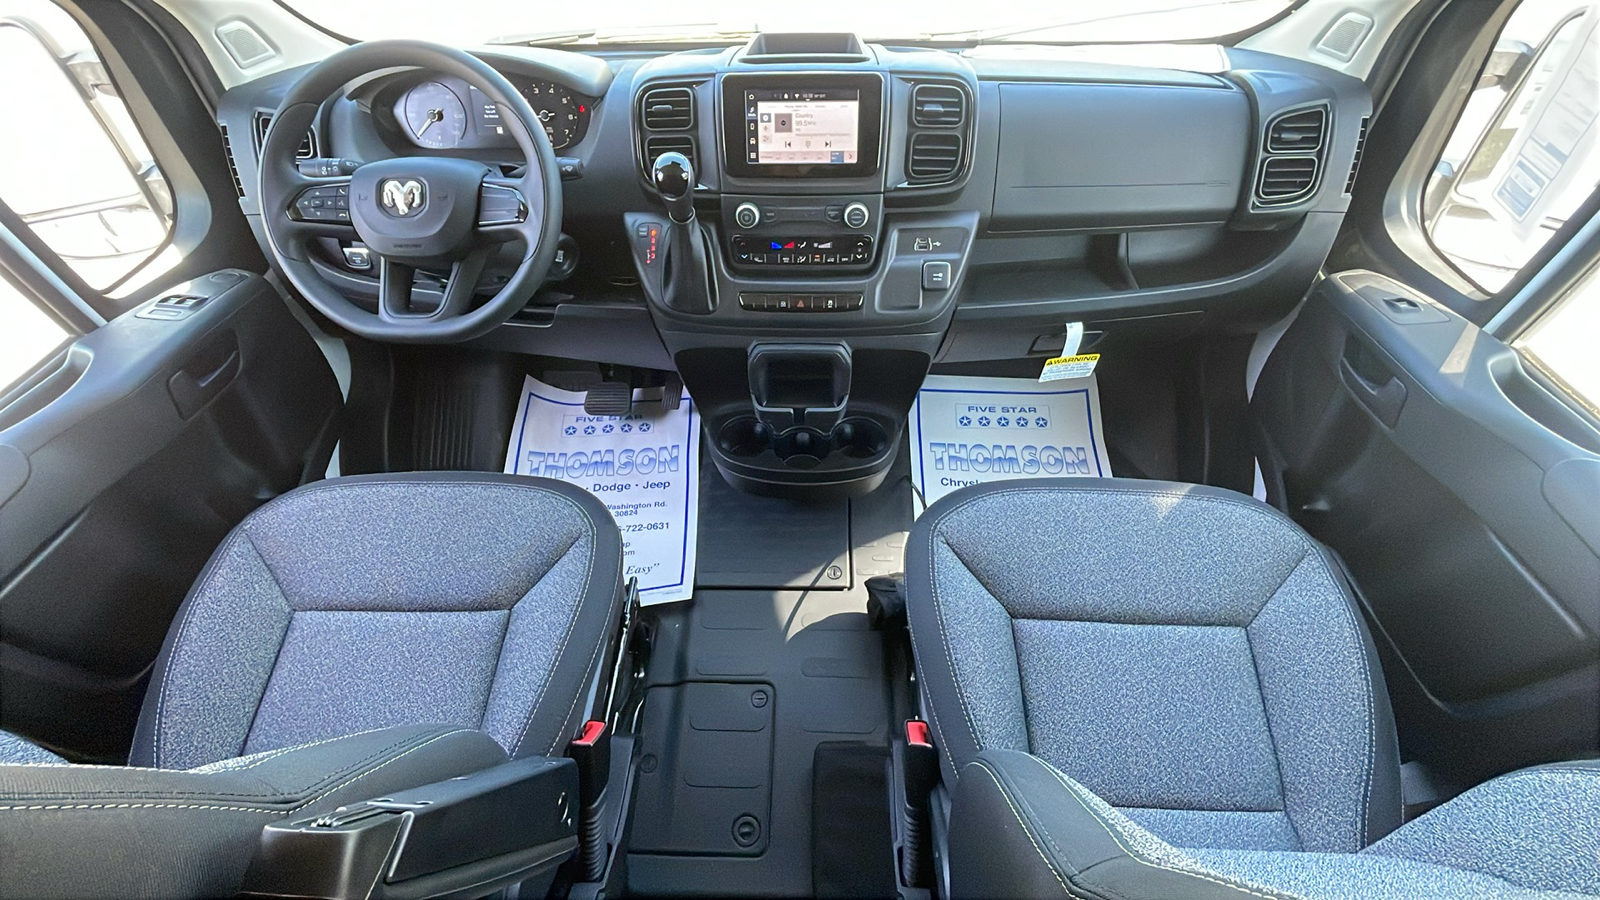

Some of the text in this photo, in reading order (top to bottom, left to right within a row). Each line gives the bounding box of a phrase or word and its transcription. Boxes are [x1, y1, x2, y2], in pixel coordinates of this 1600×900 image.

[1053, 355, 1098, 365] WARNING
[967, 405, 1037, 414] FIVE STAR
[527, 444, 680, 479] THOMSON
[929, 442, 1090, 475] THOMSON
[593, 480, 671, 492] Dodge Jeep
[614, 509, 638, 517] 30824
